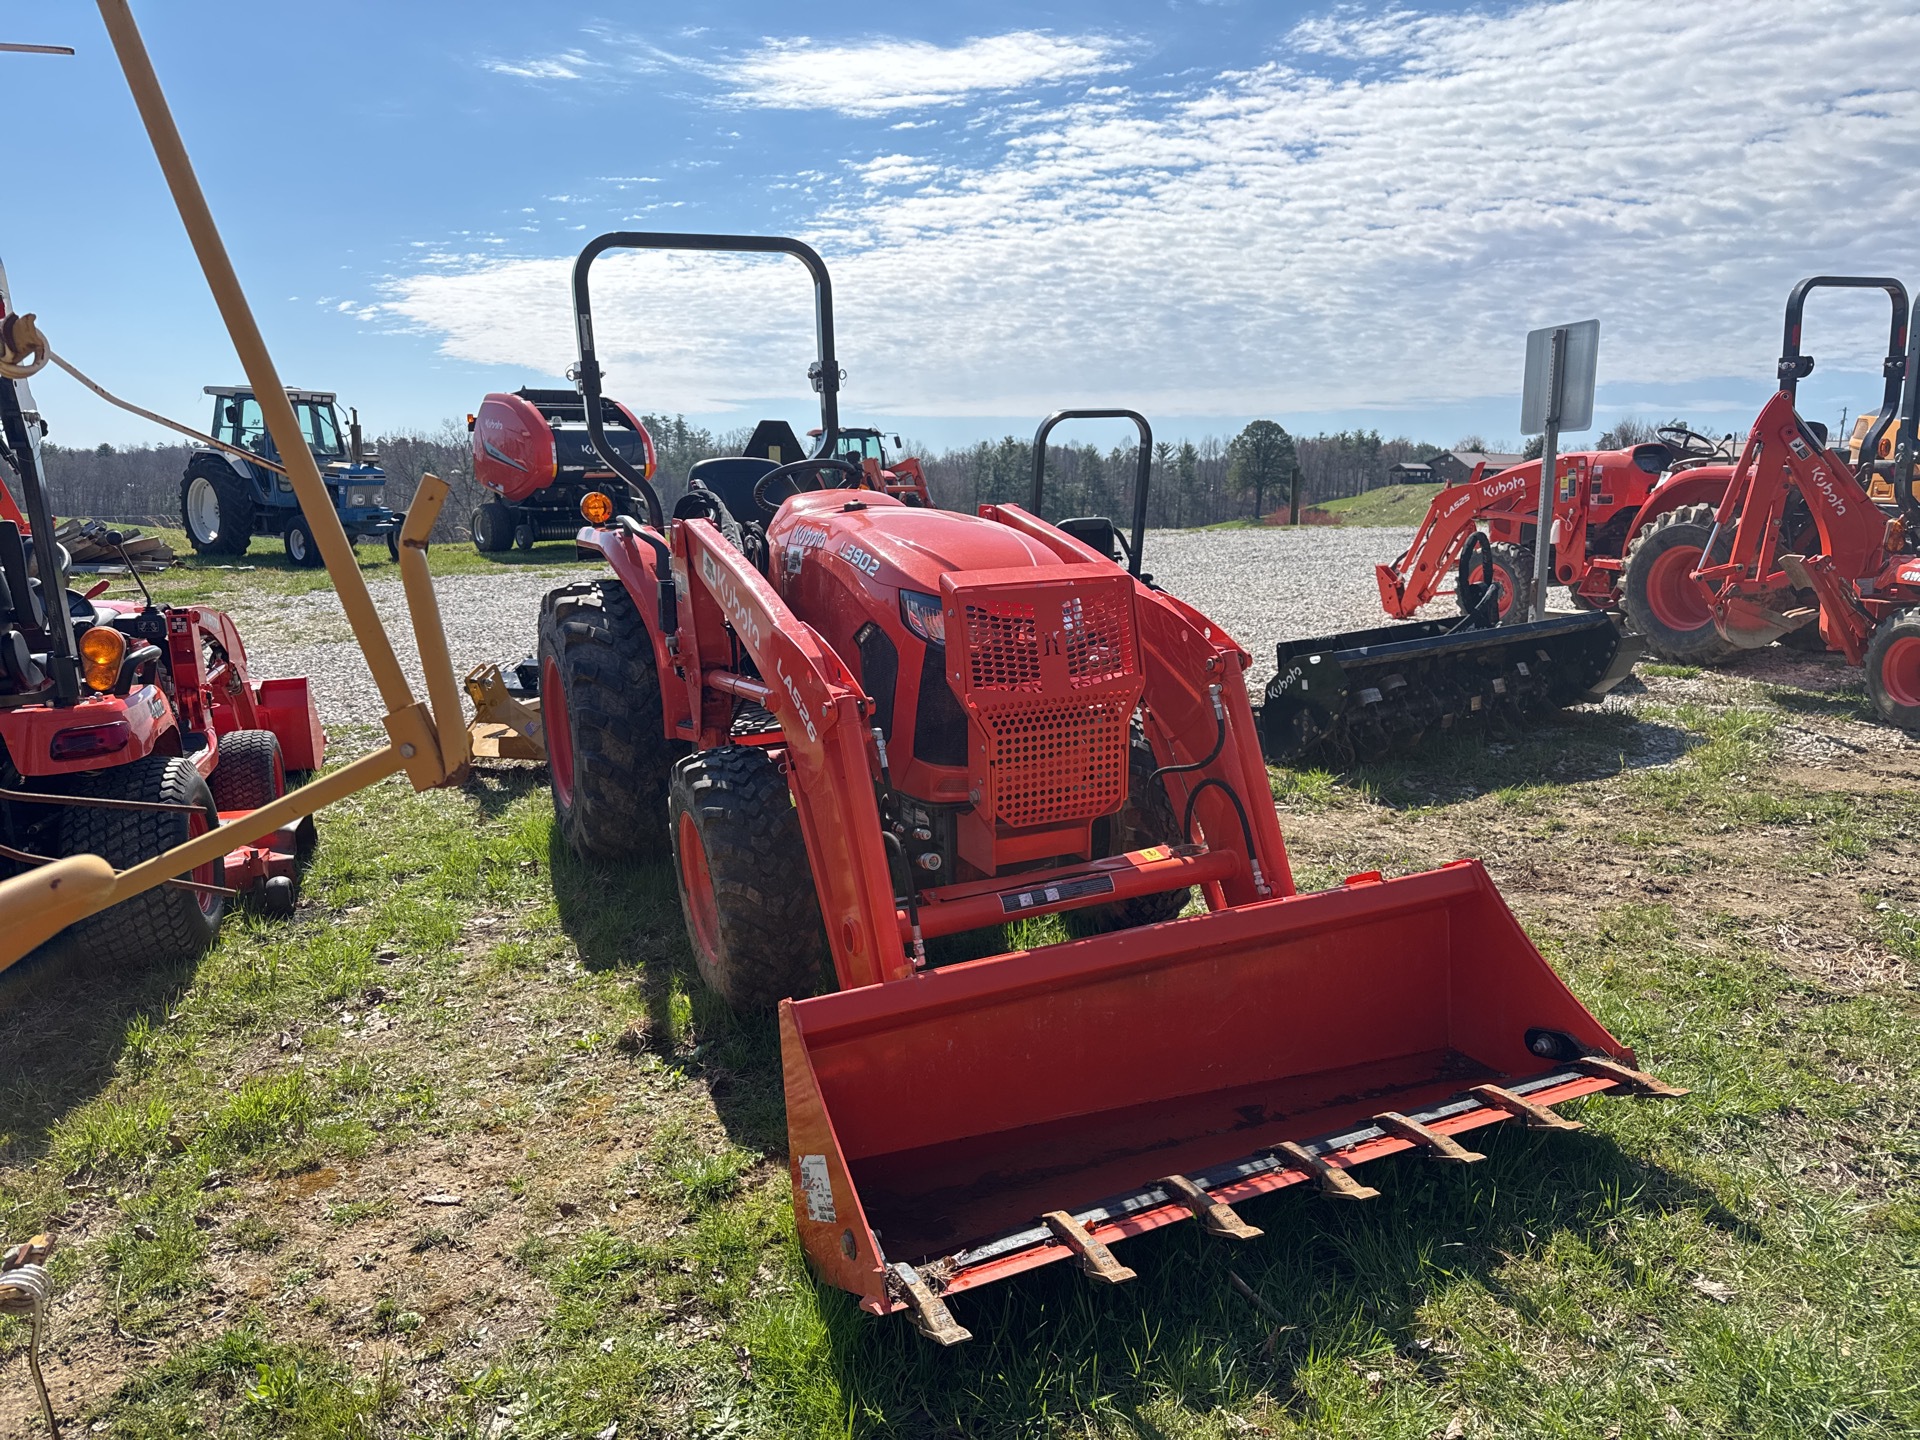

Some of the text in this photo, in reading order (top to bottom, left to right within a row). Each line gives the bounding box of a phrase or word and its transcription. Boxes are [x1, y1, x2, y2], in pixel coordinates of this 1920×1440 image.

[485, 418, 503, 430] Kubota
[1483, 476, 1525, 497] Kubota
[1811, 466, 1846, 516] Kubota
[794, 524, 828, 549] Kubota
[839, 541, 880, 577] L3902
[716, 565, 760, 650] Kubota
[776, 657, 818, 743] LA526
[1267, 666, 1302, 700] Kubota
